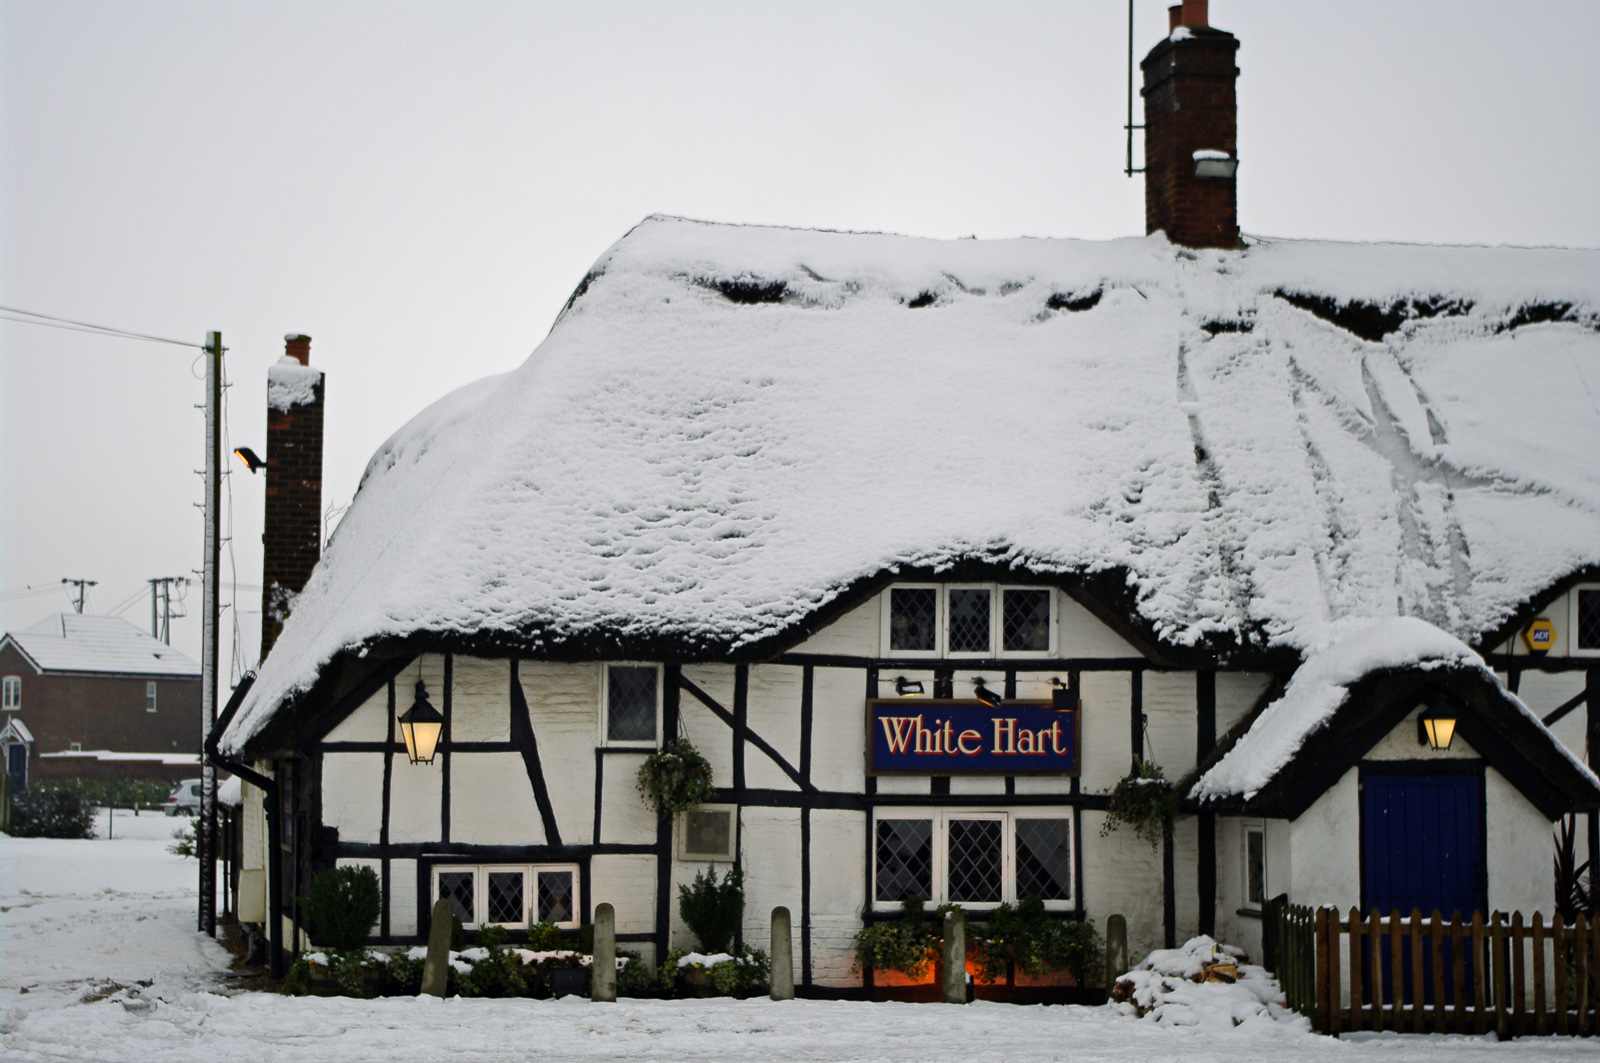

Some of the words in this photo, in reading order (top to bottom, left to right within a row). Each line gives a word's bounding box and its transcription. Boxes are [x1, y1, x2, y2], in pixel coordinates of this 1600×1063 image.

[1533, 631, 1550, 640] ADT
[877, 714, 983, 756] White
[990, 718, 1068, 756] Hart
